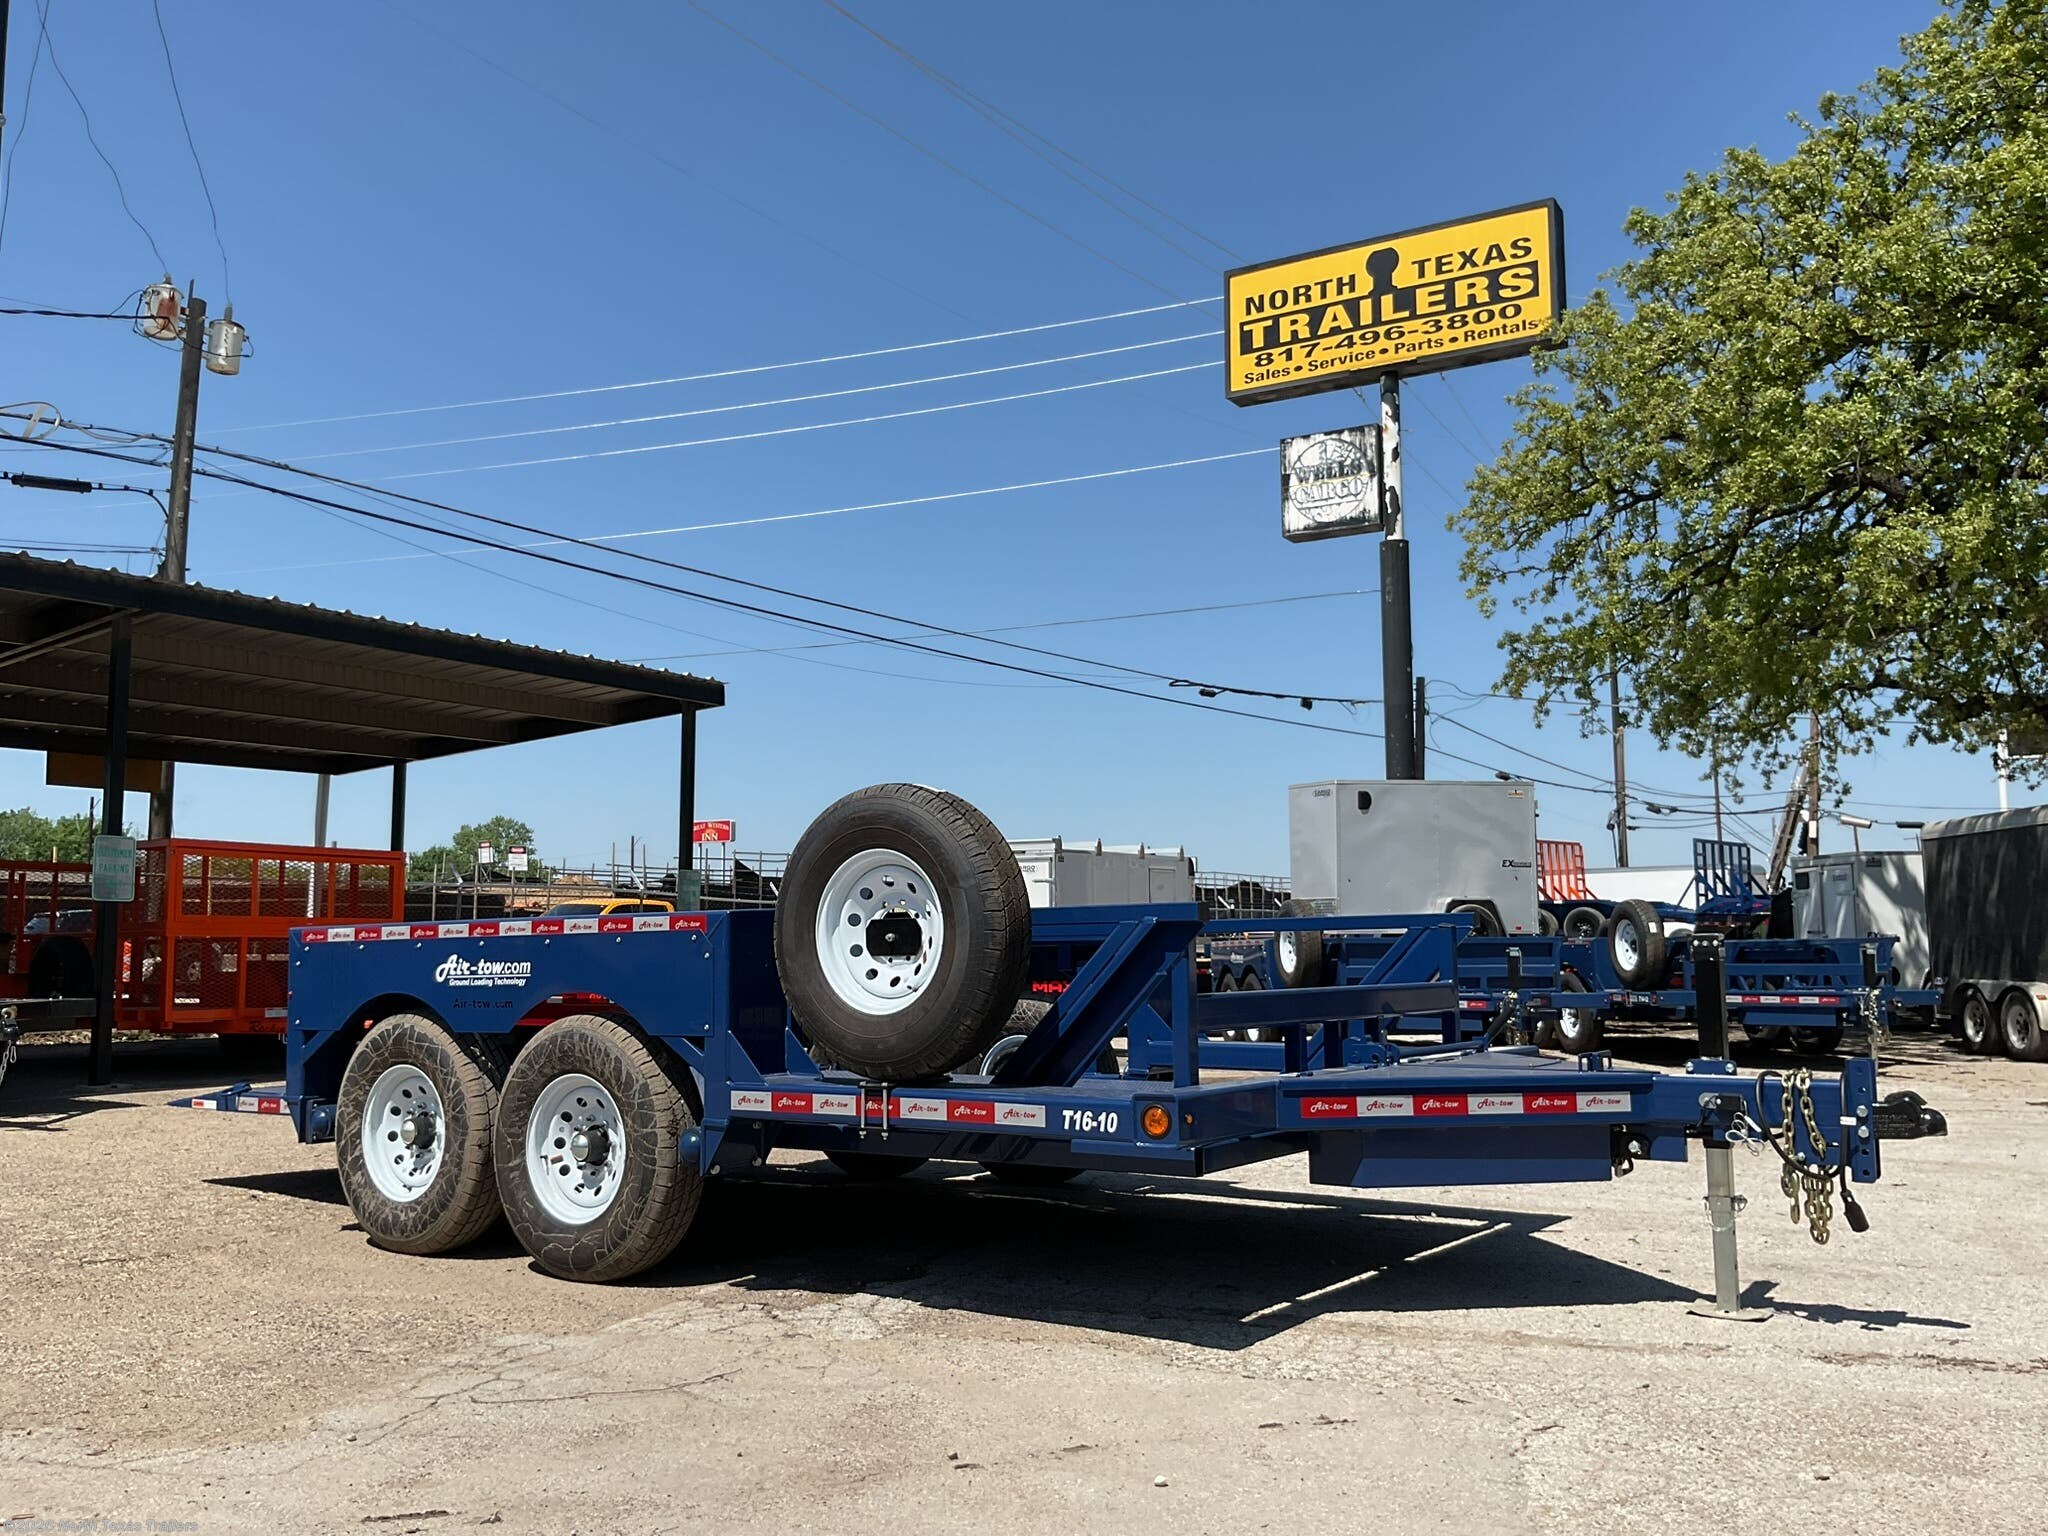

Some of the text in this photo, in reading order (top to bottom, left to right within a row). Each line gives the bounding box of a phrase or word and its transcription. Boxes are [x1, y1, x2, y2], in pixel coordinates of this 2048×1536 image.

[1245, 237, 1532, 316] NORTH TEXAS
[1243, 267, 1534, 349] TRAILERS
[1254, 304, 1522, 367] 817-496-3800
[1244, 319, 1539, 384] Sales Service Parts Rentals
[701, 832, 719, 841] INN
[435, 954, 532, 983] Air-tow.com
[449, 977, 527, 987] Ground Loading Technology
[738, 1095, 764, 1105] Air-tow
[778, 1097, 807, 1107] Air-tow
[820, 1099, 849, 1109] Air-tow
[908, 1103, 939, 1113] Air-tow
[954, 1105, 987, 1116] Air-tow
[1003, 1108, 1037, 1119] Air-tow
[1310, 1096, 1622, 1112] Air-tow Air-tow Air-tow Air-tow Air-tow Air-tow
[1062, 1109, 1118, 1133] T16-10
